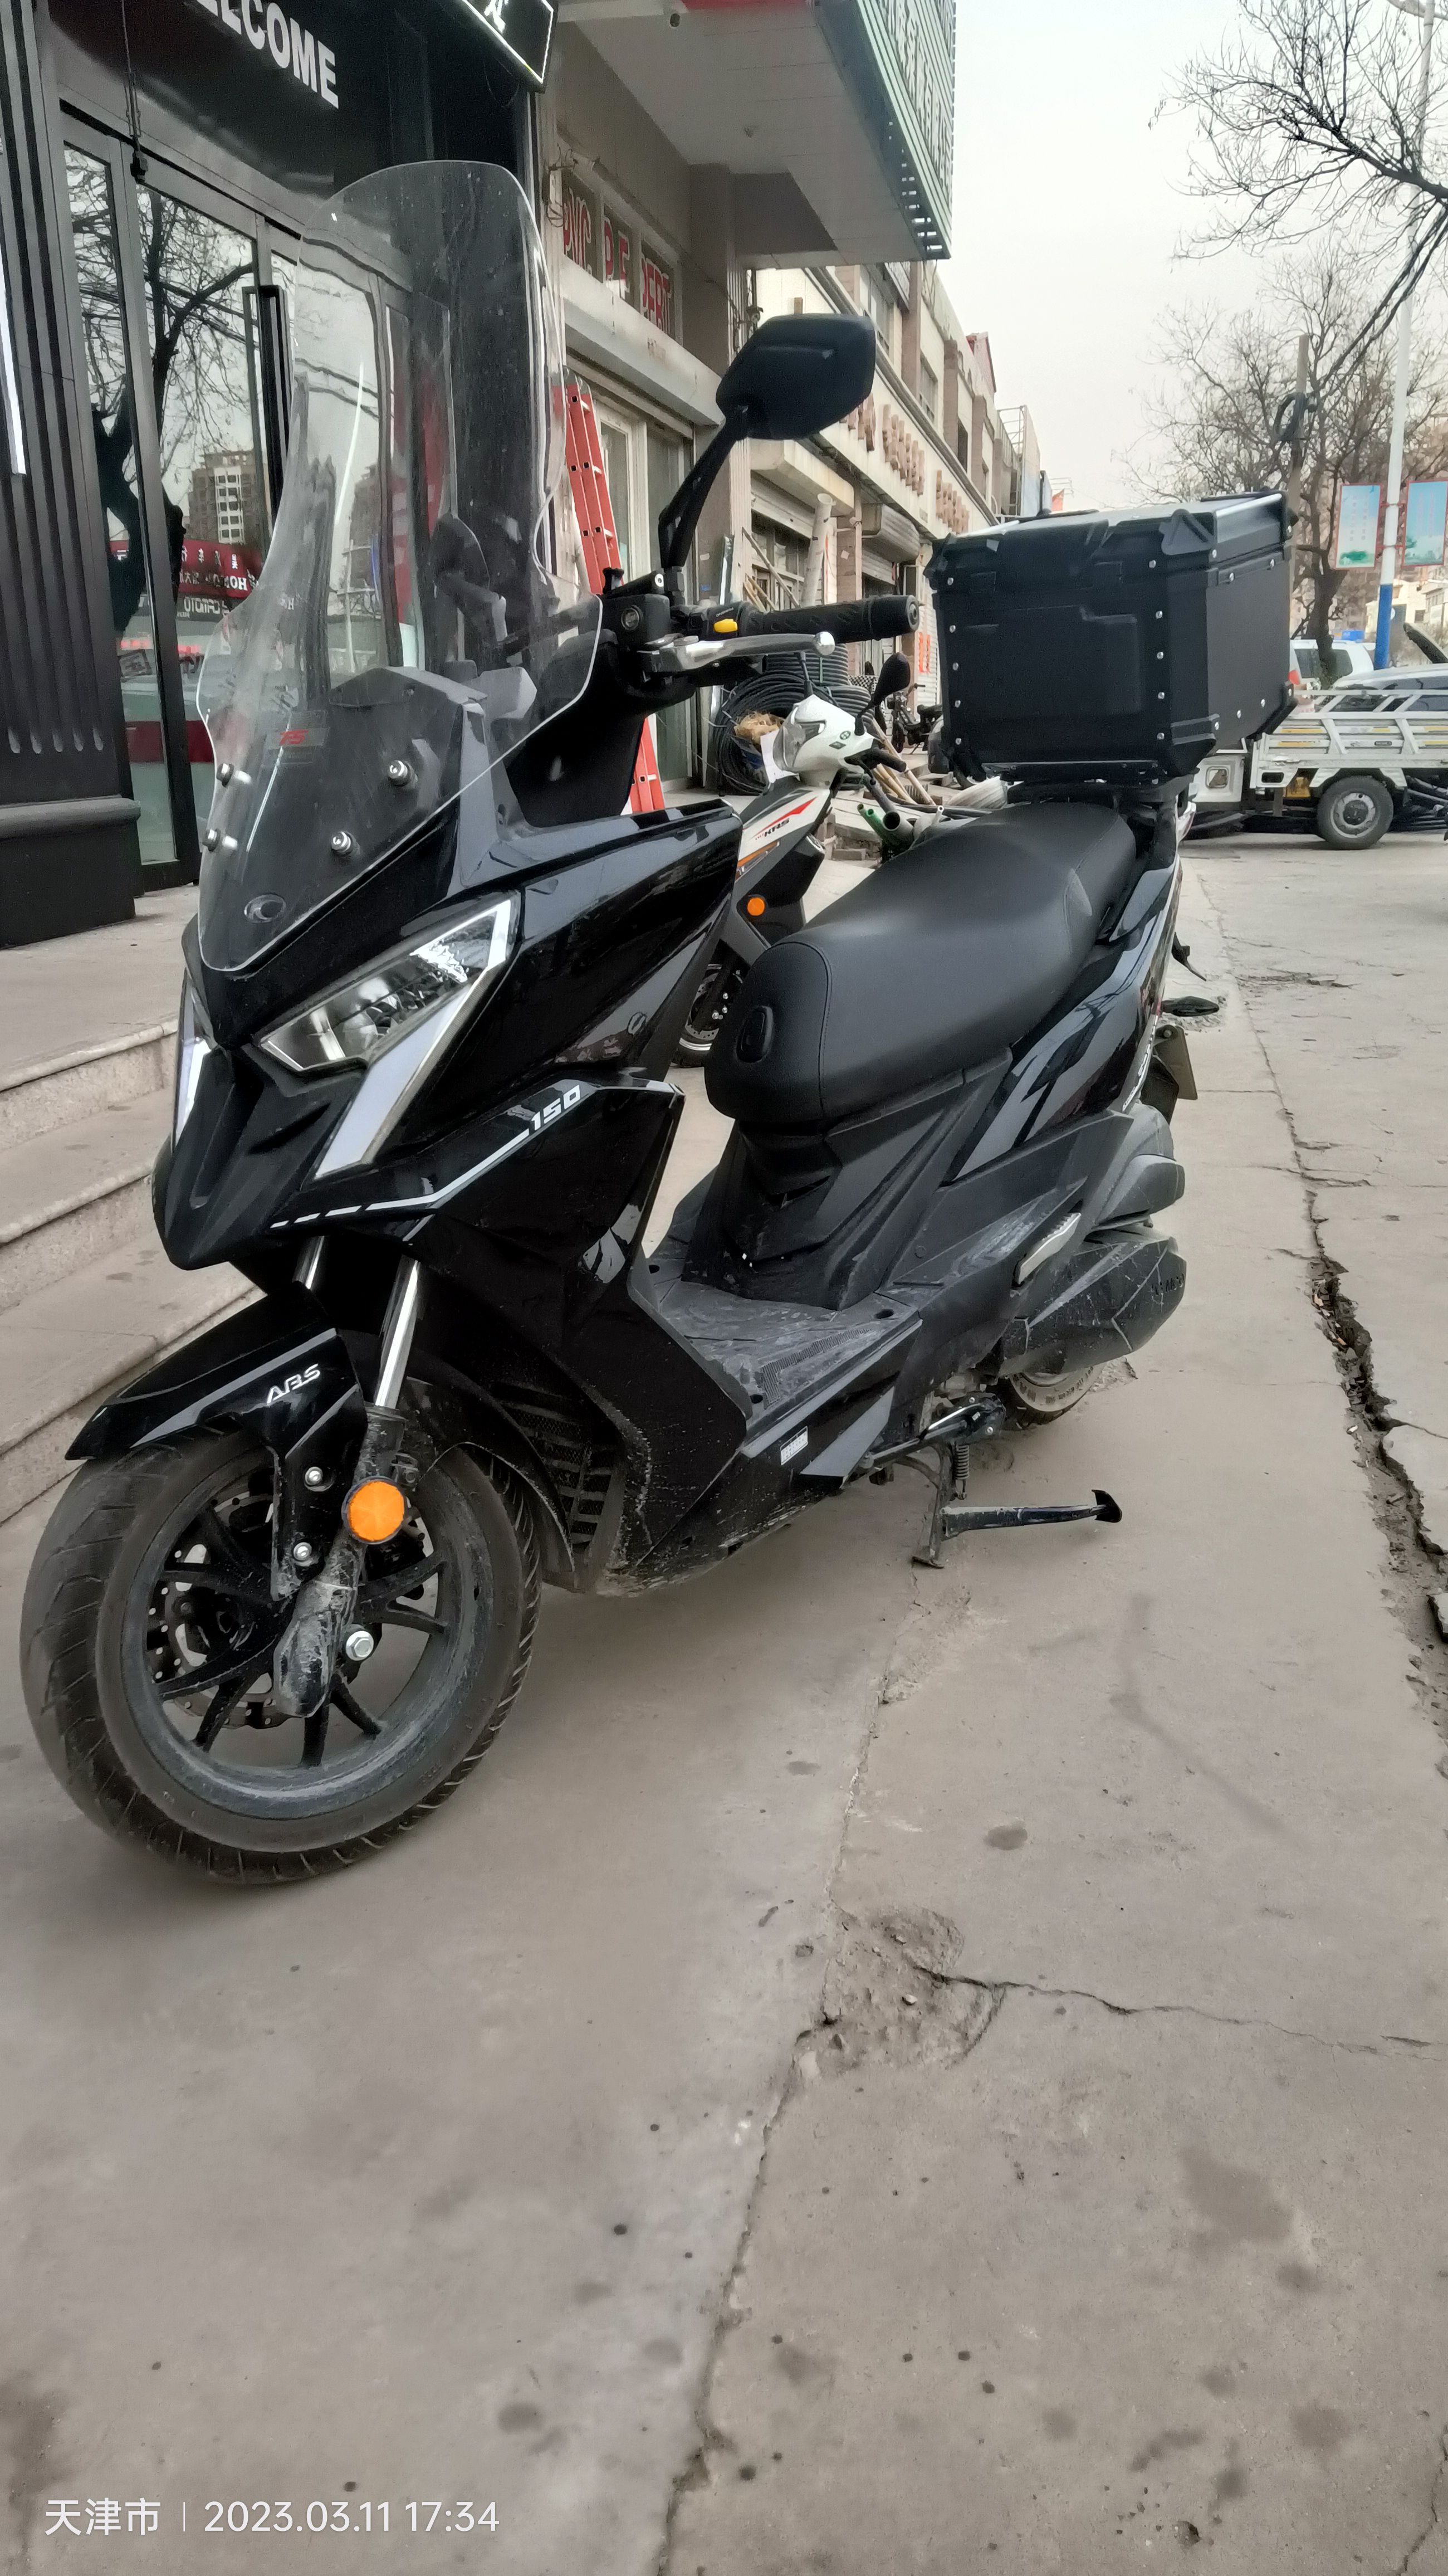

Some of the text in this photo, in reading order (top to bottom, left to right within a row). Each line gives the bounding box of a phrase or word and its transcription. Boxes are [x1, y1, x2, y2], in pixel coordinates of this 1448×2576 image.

[198, 0, 339, 109] LCOME
[531, 1085, 581, 1130] 150
[266, 1363, 321, 1405] ABS
